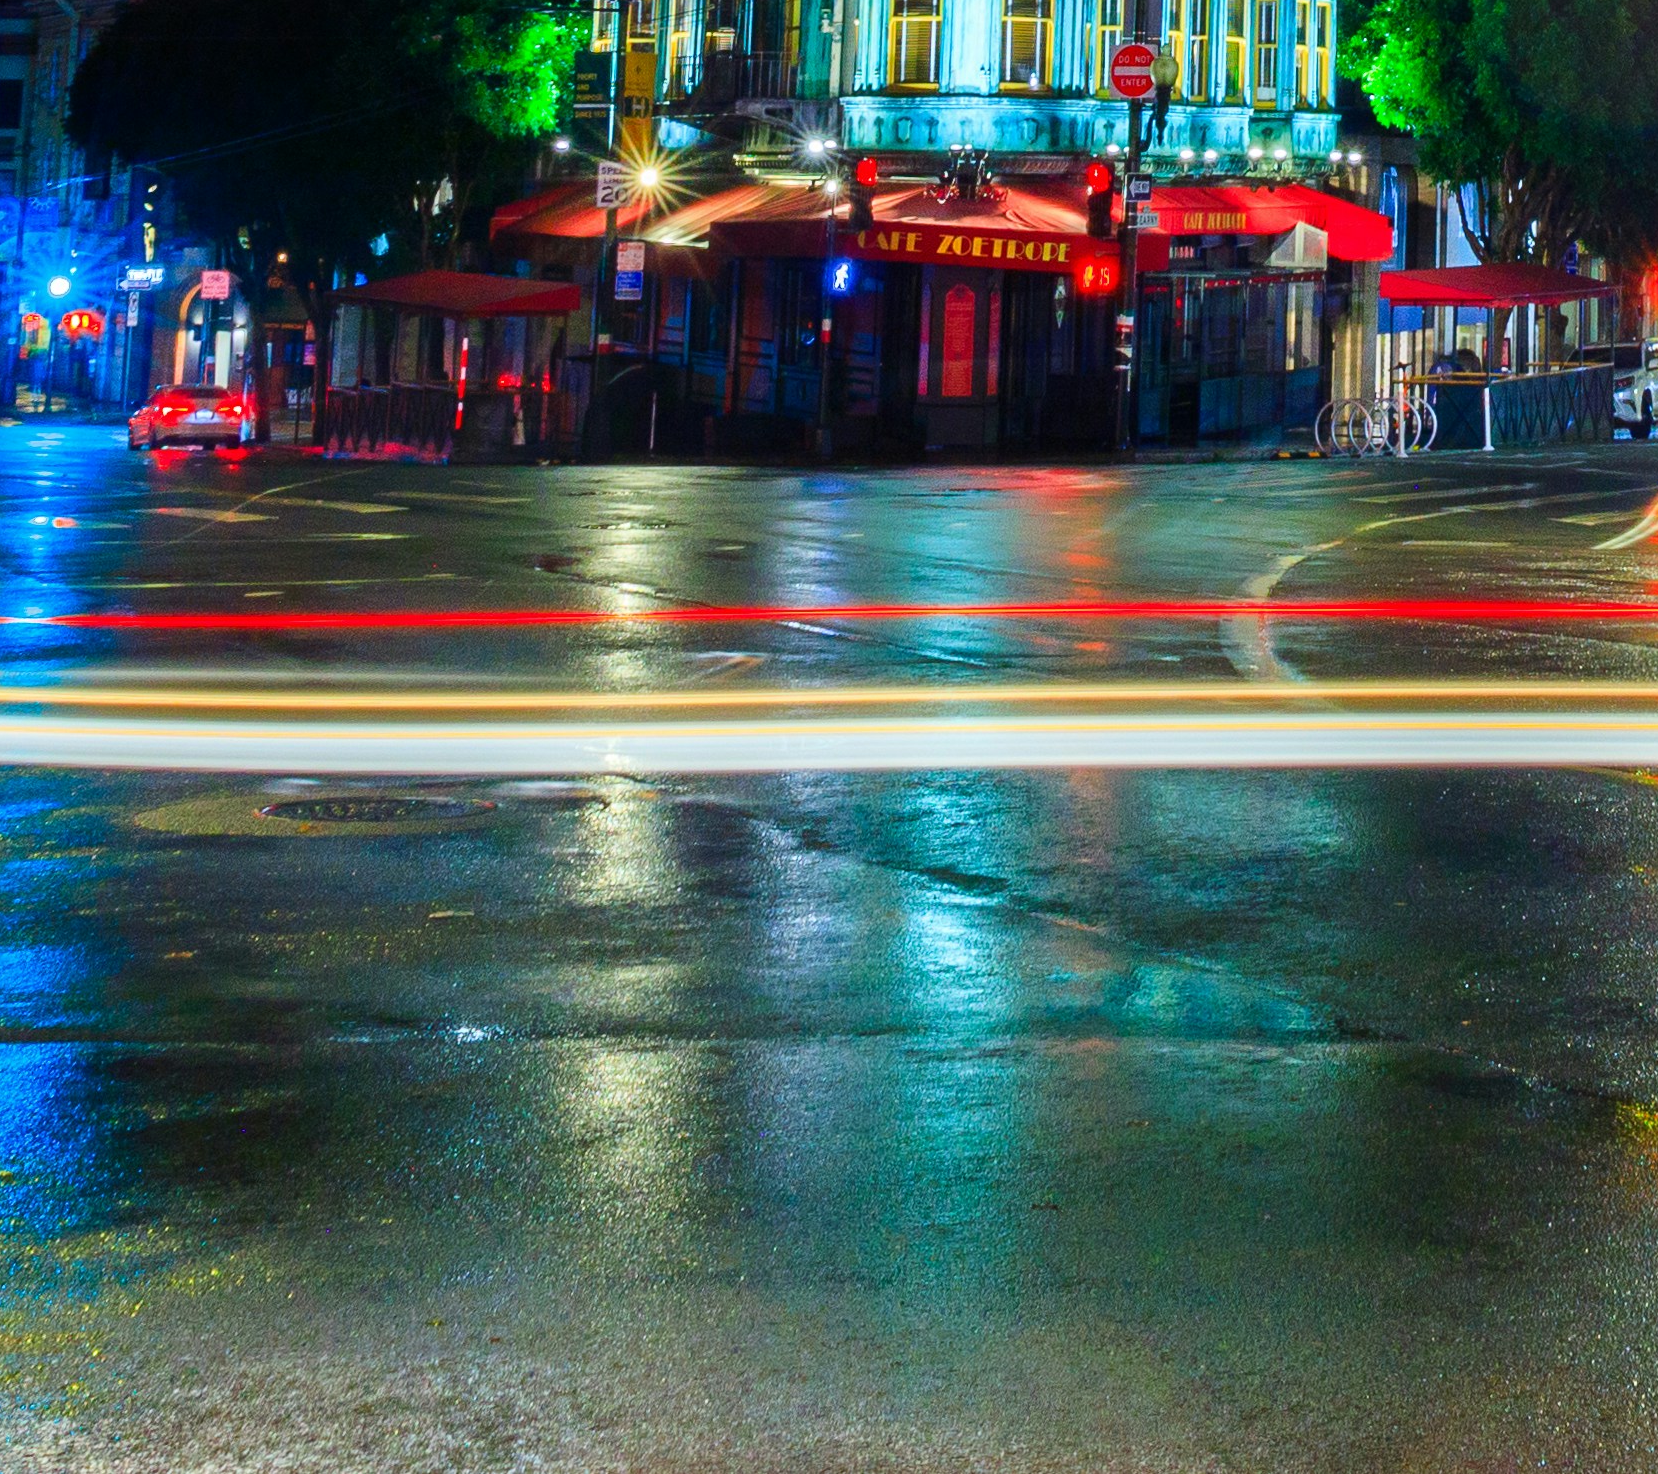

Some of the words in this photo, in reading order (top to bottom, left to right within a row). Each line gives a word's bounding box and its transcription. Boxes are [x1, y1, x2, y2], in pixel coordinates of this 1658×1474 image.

[1118, 55, 1130, 64] DO
[1135, 55, 1151, 64] NOT
[1120, 78, 1147, 87] ENTER
[600, 185, 628, 203] 20
[857, 229, 923, 253] CAFE
[936, 234, 1071, 263] ZOETROPE
